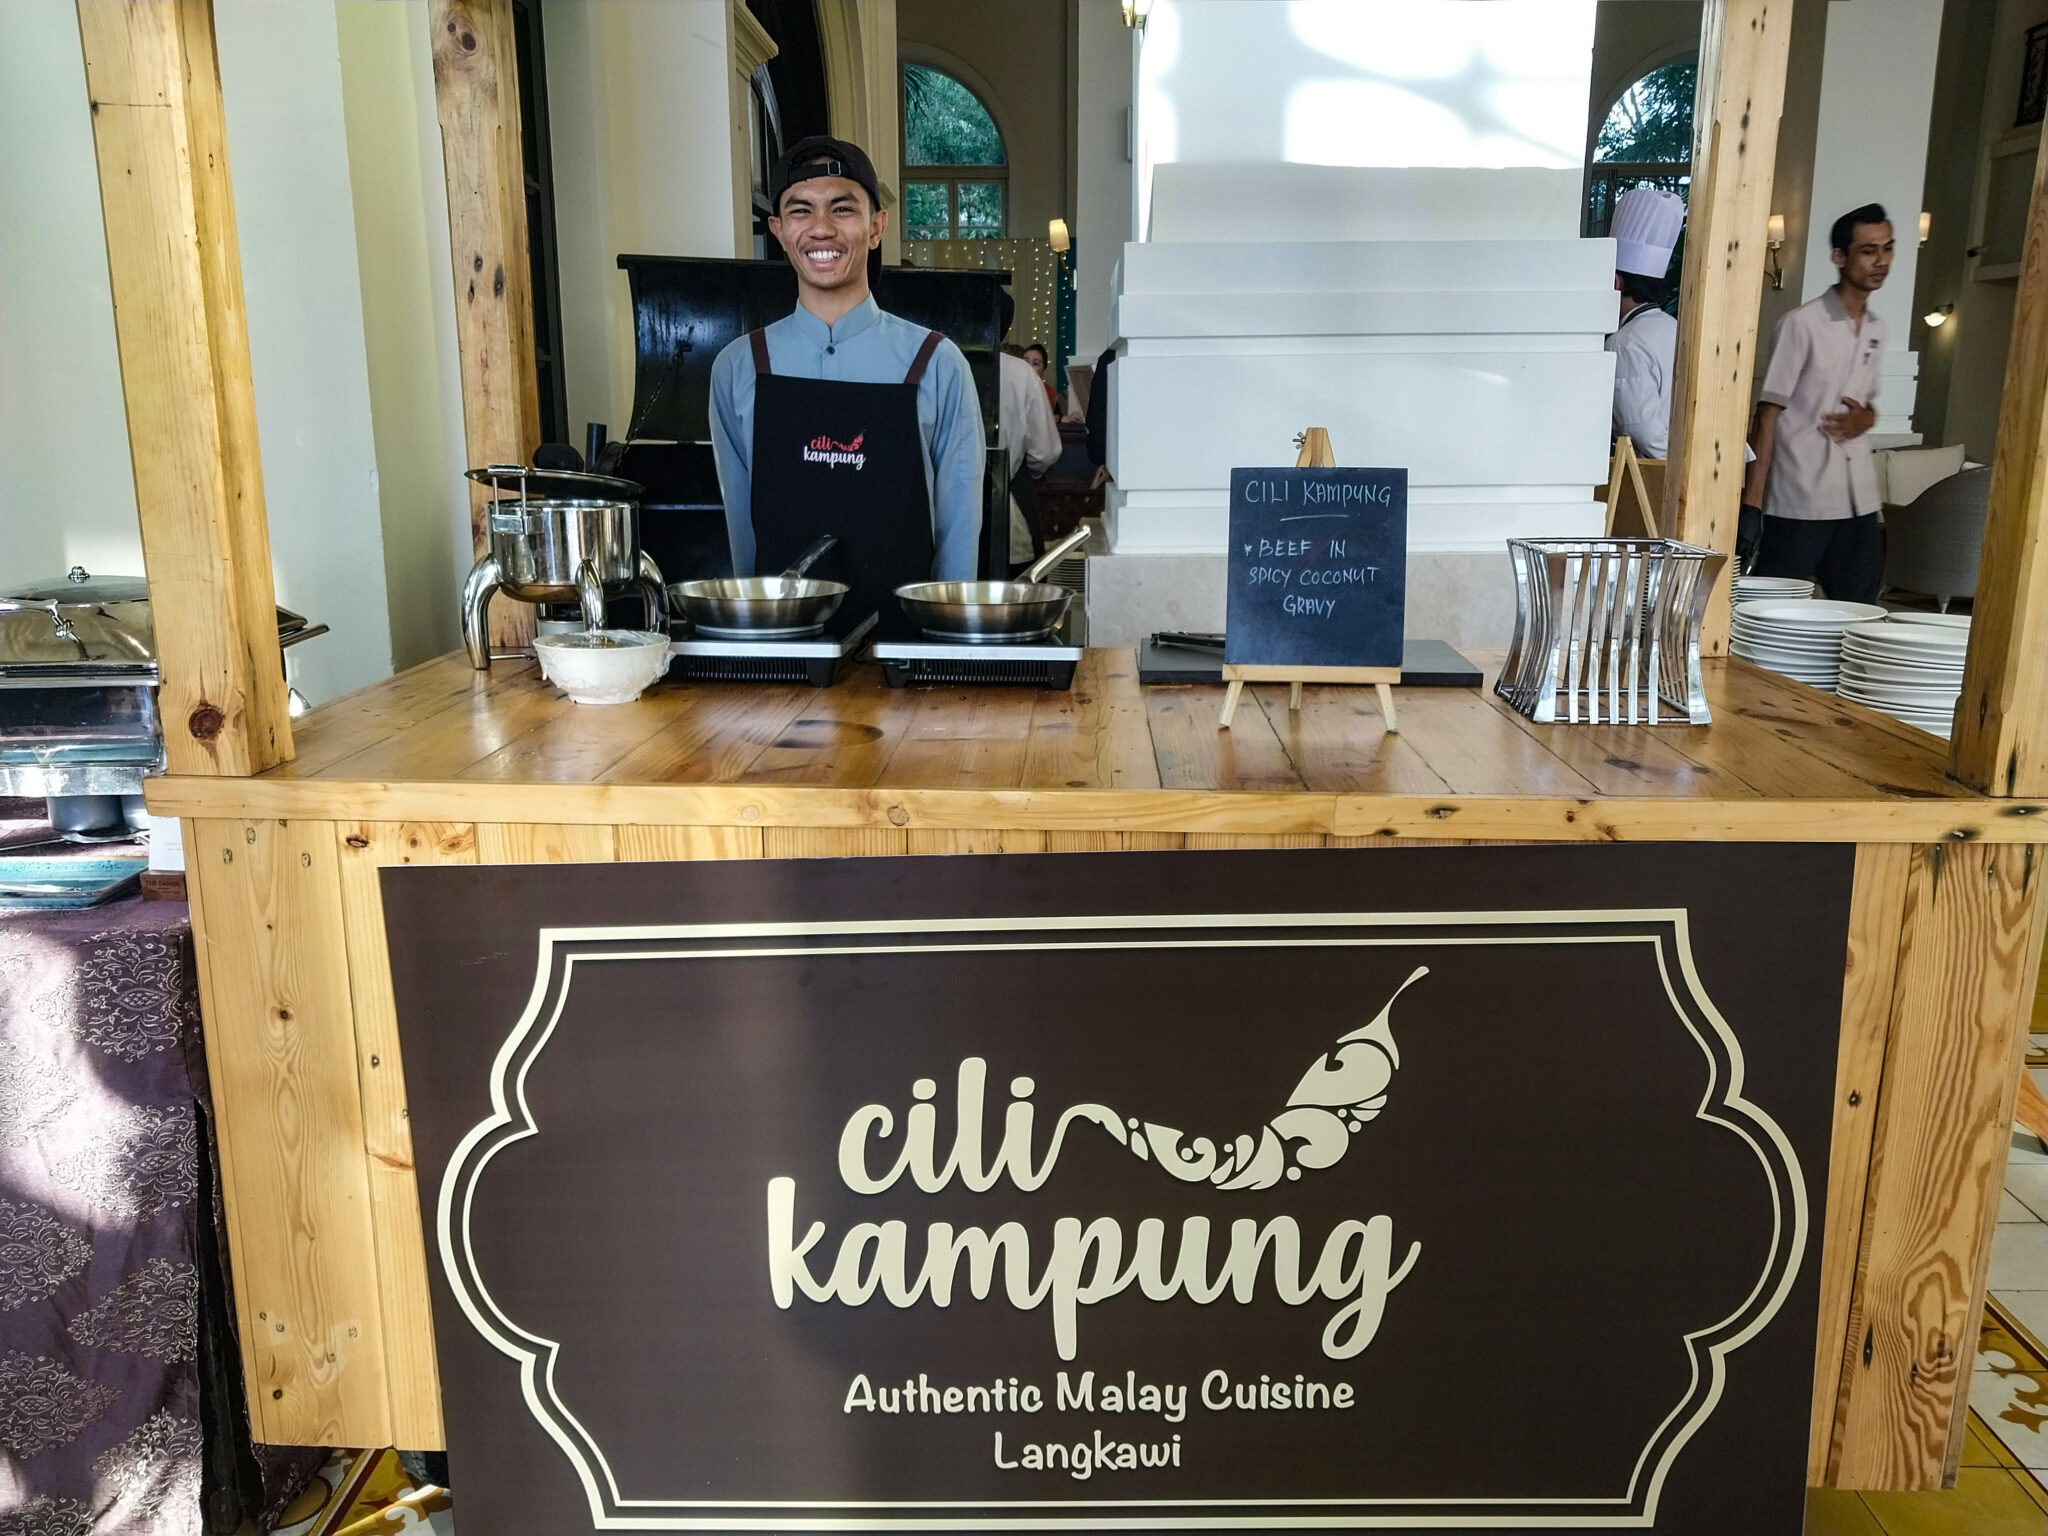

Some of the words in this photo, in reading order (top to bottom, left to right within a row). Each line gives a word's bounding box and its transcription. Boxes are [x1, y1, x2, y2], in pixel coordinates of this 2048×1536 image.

[810, 434, 833, 451] cili
[803, 445, 866, 471] kampung
[1245, 480, 1289, 503] CILI
[1258, 538, 1312, 558] BEEF
[1329, 539, 1347, 559] IN
[1246, 566, 1292, 588] SPICY
[1299, 566, 1380, 586] COCONUT
[1282, 594, 1336, 619] GRAVY
[838, 1056, 1095, 1195] cili
[766, 1176, 1422, 1361] kampung
[843, 1373, 1043, 1415] Authentic
[1056, 1371, 1188, 1423] Malay
[1200, 1369, 1356, 1411] Cuisine
[994, 1431, 1182, 1481] Langkawi
